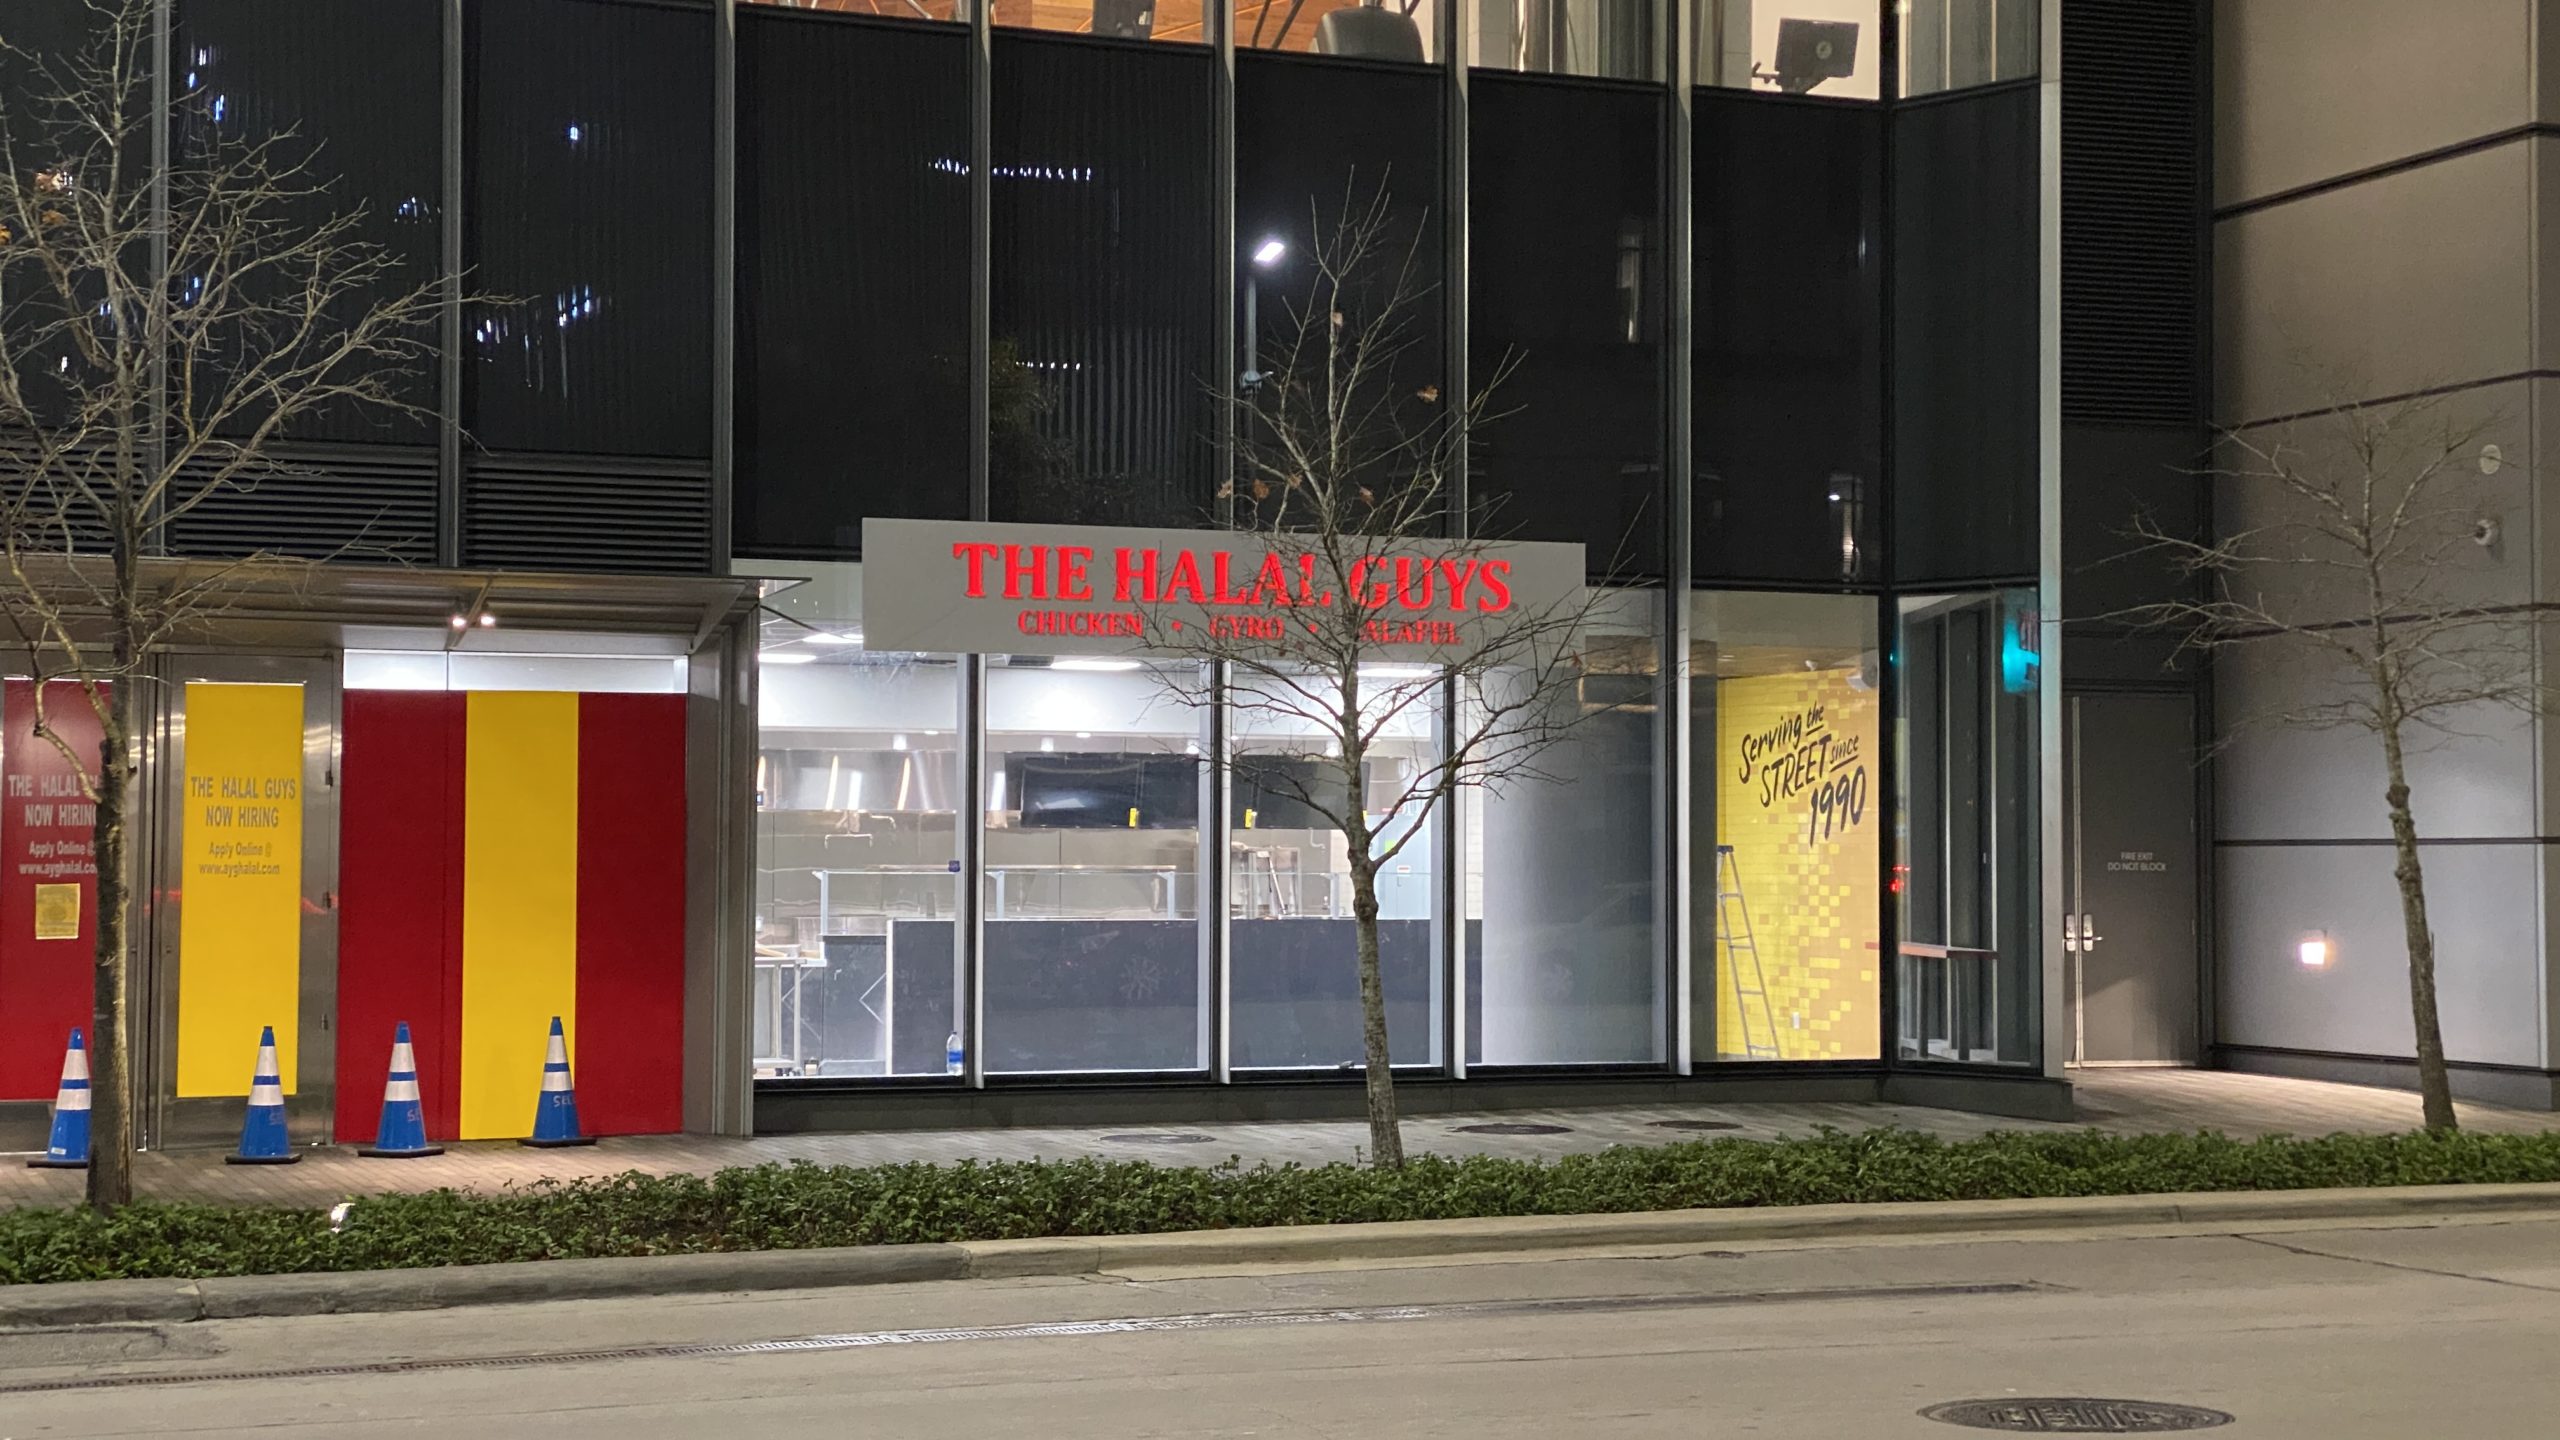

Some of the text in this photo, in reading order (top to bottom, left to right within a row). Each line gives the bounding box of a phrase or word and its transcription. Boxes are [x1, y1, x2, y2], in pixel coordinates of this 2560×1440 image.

[953, 542, 1513, 613] THE HALAL GUYS
[1017, 609, 1463, 645] CHICKEN GYRO ALAFEL
[1739, 700, 1824, 784] Serving the
[1760, 733, 1859, 808] STREET since
[8, 775, 32, 797] THE
[41, 775, 79, 797] HALAL
[191, 777, 296, 800] THE HALAL GUYS
[25, 804, 53, 827] NOW
[206, 806, 279, 828] NOW HIRING
[1810, 765, 1867, 848] 1990
[29, 841, 54, 858] Apply
[57, 840, 86, 855] Online
[209, 842, 233, 858] Apply
[236, 842, 263, 856] Online
[19, 861, 97, 878] www.ayghalal.co
[199, 862, 280, 878] www.ayghalal.com
[2107, 862, 2167, 871] DO NOT BLOCK
